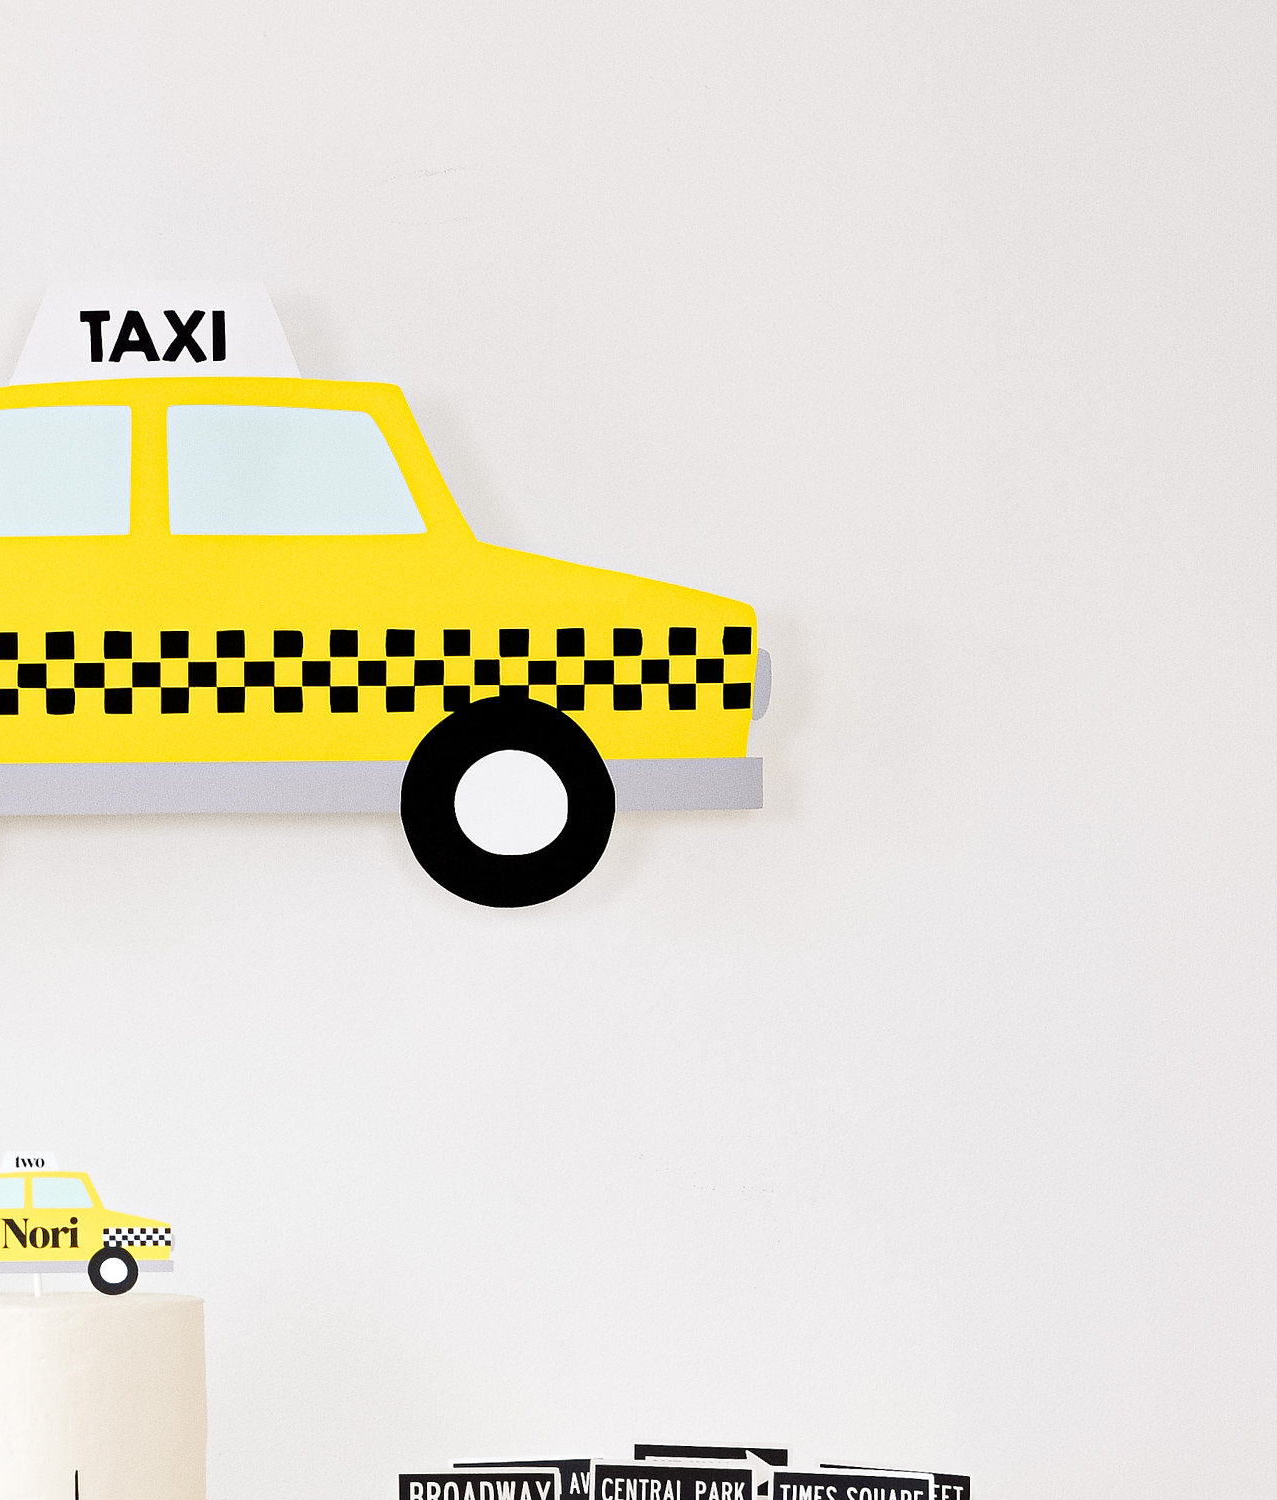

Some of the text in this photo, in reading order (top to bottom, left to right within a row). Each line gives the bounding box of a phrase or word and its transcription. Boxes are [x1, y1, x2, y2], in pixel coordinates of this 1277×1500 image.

[80, 310, 226, 362] TAXI
[15, 1156, 45, 1168] two
[1, 1217, 80, 1249] Nori
